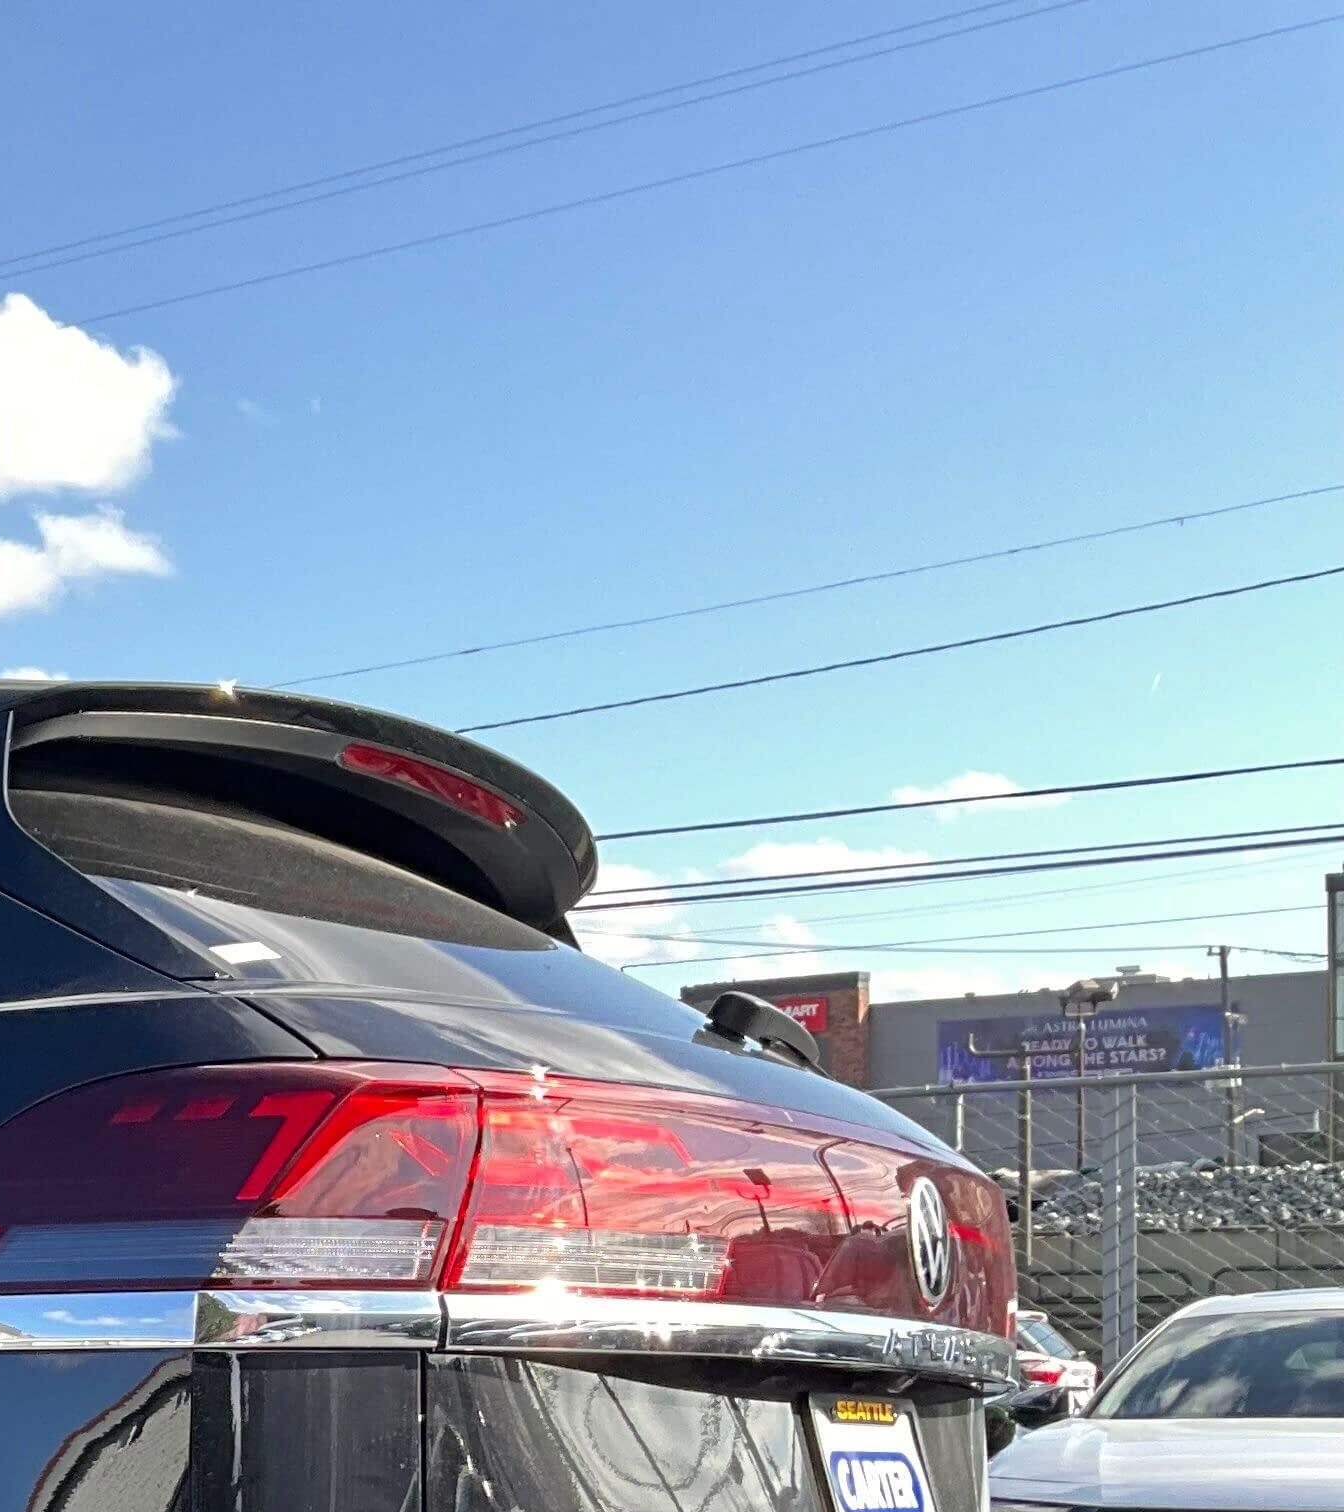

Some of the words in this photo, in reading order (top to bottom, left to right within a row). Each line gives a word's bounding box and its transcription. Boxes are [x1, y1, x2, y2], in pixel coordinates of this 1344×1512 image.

[1043, 1020, 1086, 1033] ASTR
[1091, 1016, 1148, 1031] LUMINA
[1022, 1039, 1072, 1051] EADY
[1102, 1034, 1147, 1049] WALK
[1007, 1054, 1071, 1069] AONG
[1075, 1051, 1104, 1065] HE
[1110, 1048, 1166, 1063] STARS?
[836, 1400, 894, 1422] SEATTLE
[837, 1458, 920, 1510] CARTER
